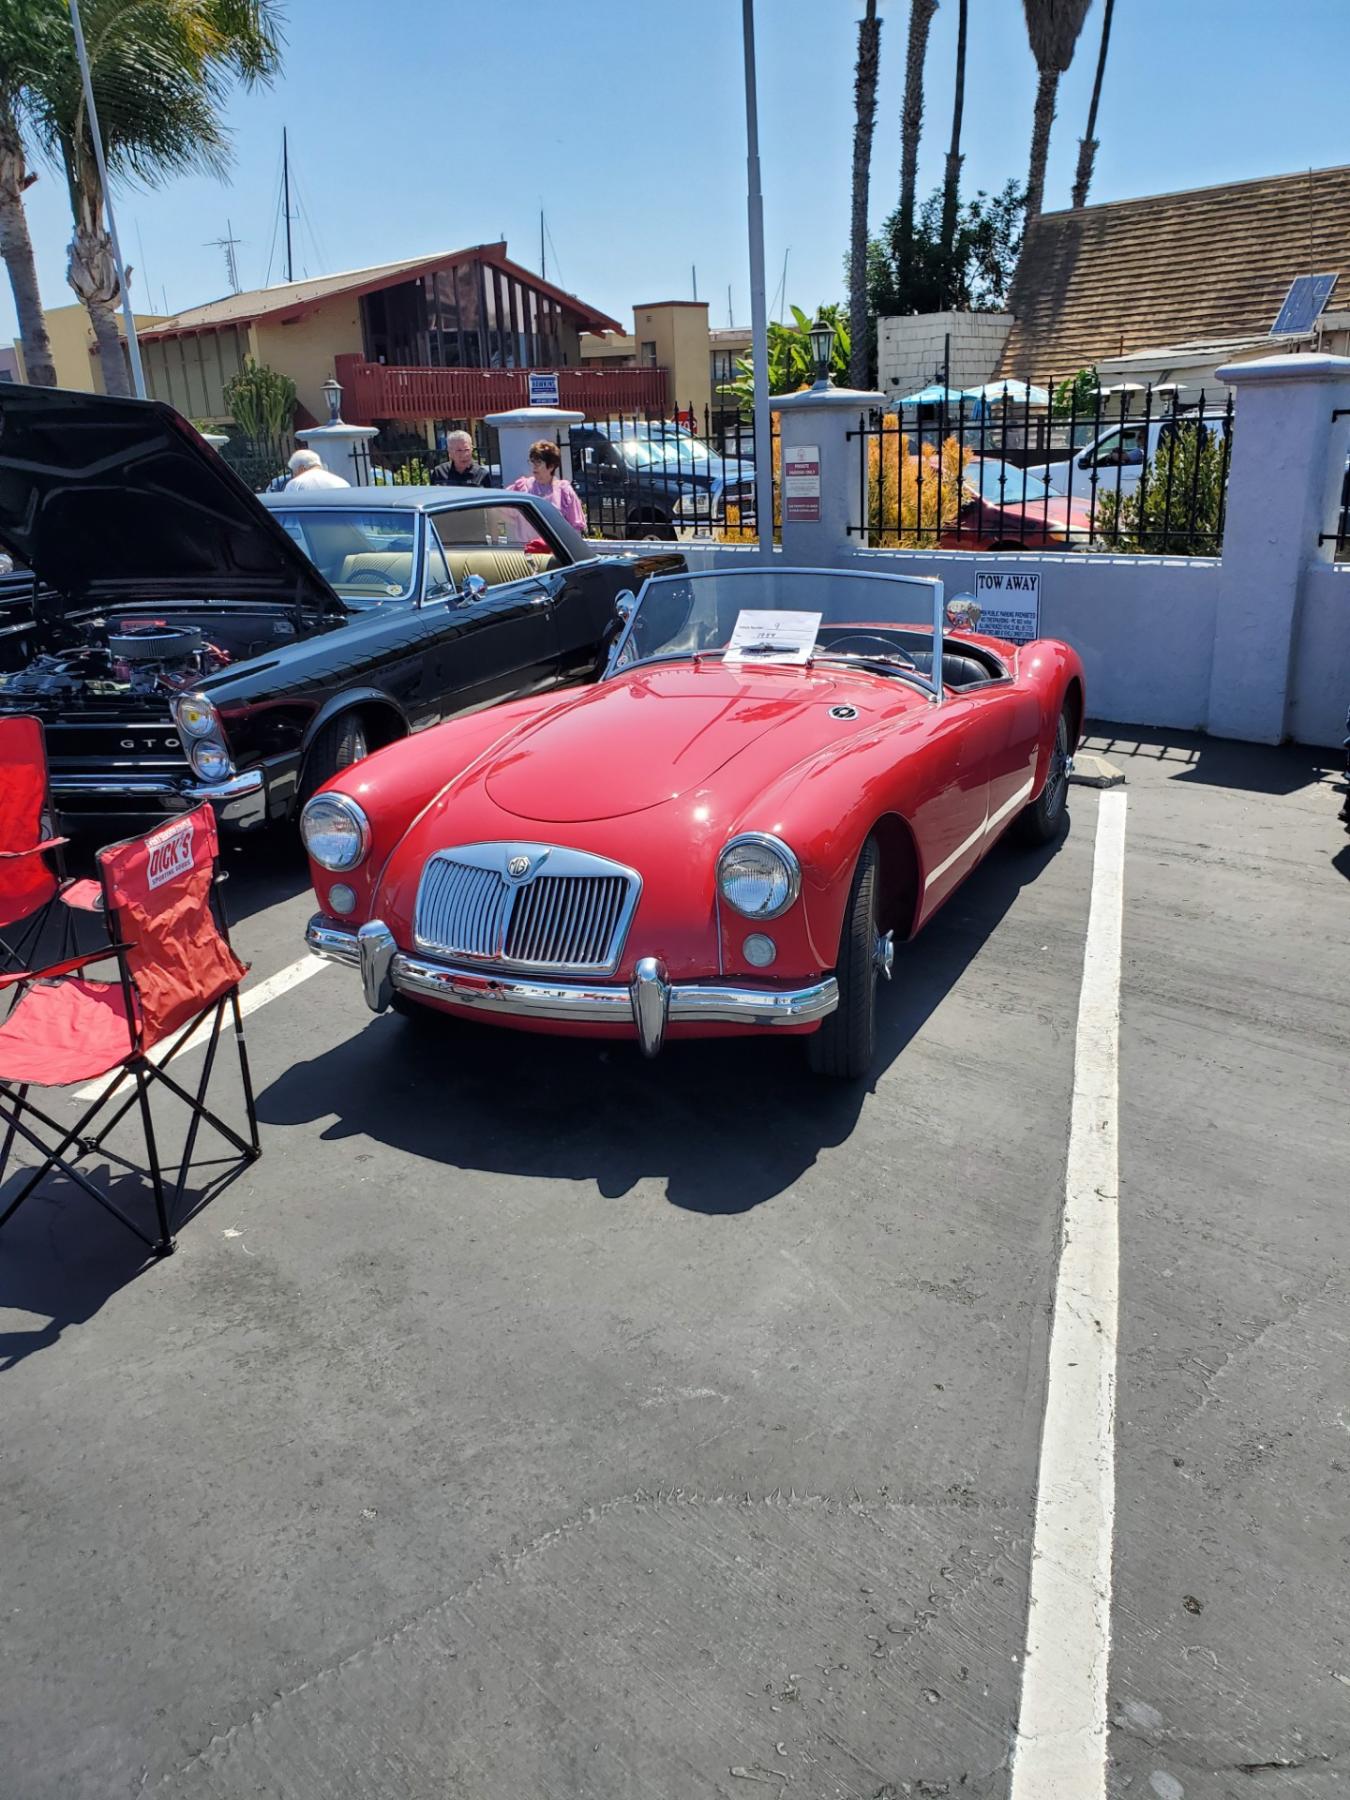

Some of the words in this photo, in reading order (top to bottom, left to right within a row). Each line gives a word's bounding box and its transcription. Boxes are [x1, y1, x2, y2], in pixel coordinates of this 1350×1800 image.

[978, 575, 1003, 590] TOW
[1005, 576, 1037, 591] AWAY
[120, 738, 180, 748] GTO
[150, 833, 191, 877] DICK'S
[509, 858, 527, 875] MG
[152, 870, 175, 885] SPORTING
